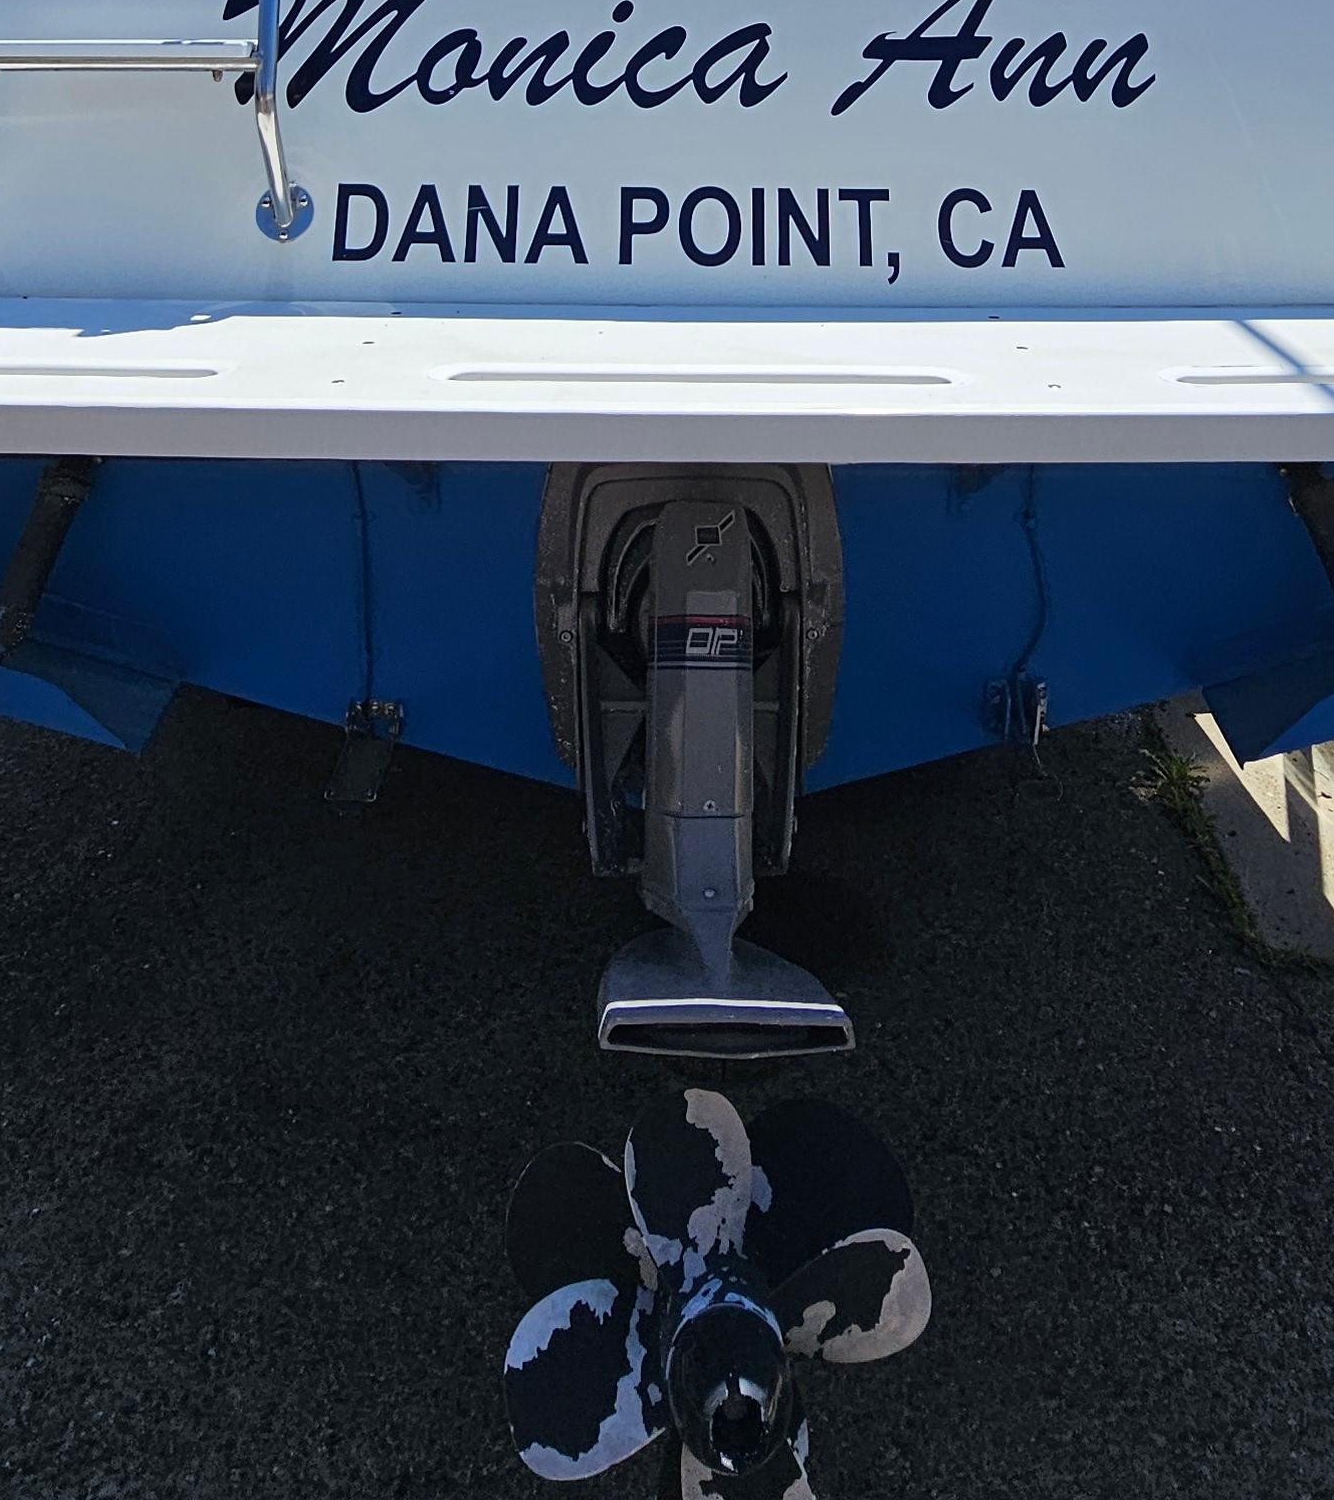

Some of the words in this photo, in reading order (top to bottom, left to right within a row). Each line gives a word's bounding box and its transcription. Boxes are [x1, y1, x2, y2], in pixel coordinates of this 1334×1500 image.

[331, 183, 589, 264] DANA
[619, 185, 901, 285] POINT,
[937, 188, 1067, 269] CA
